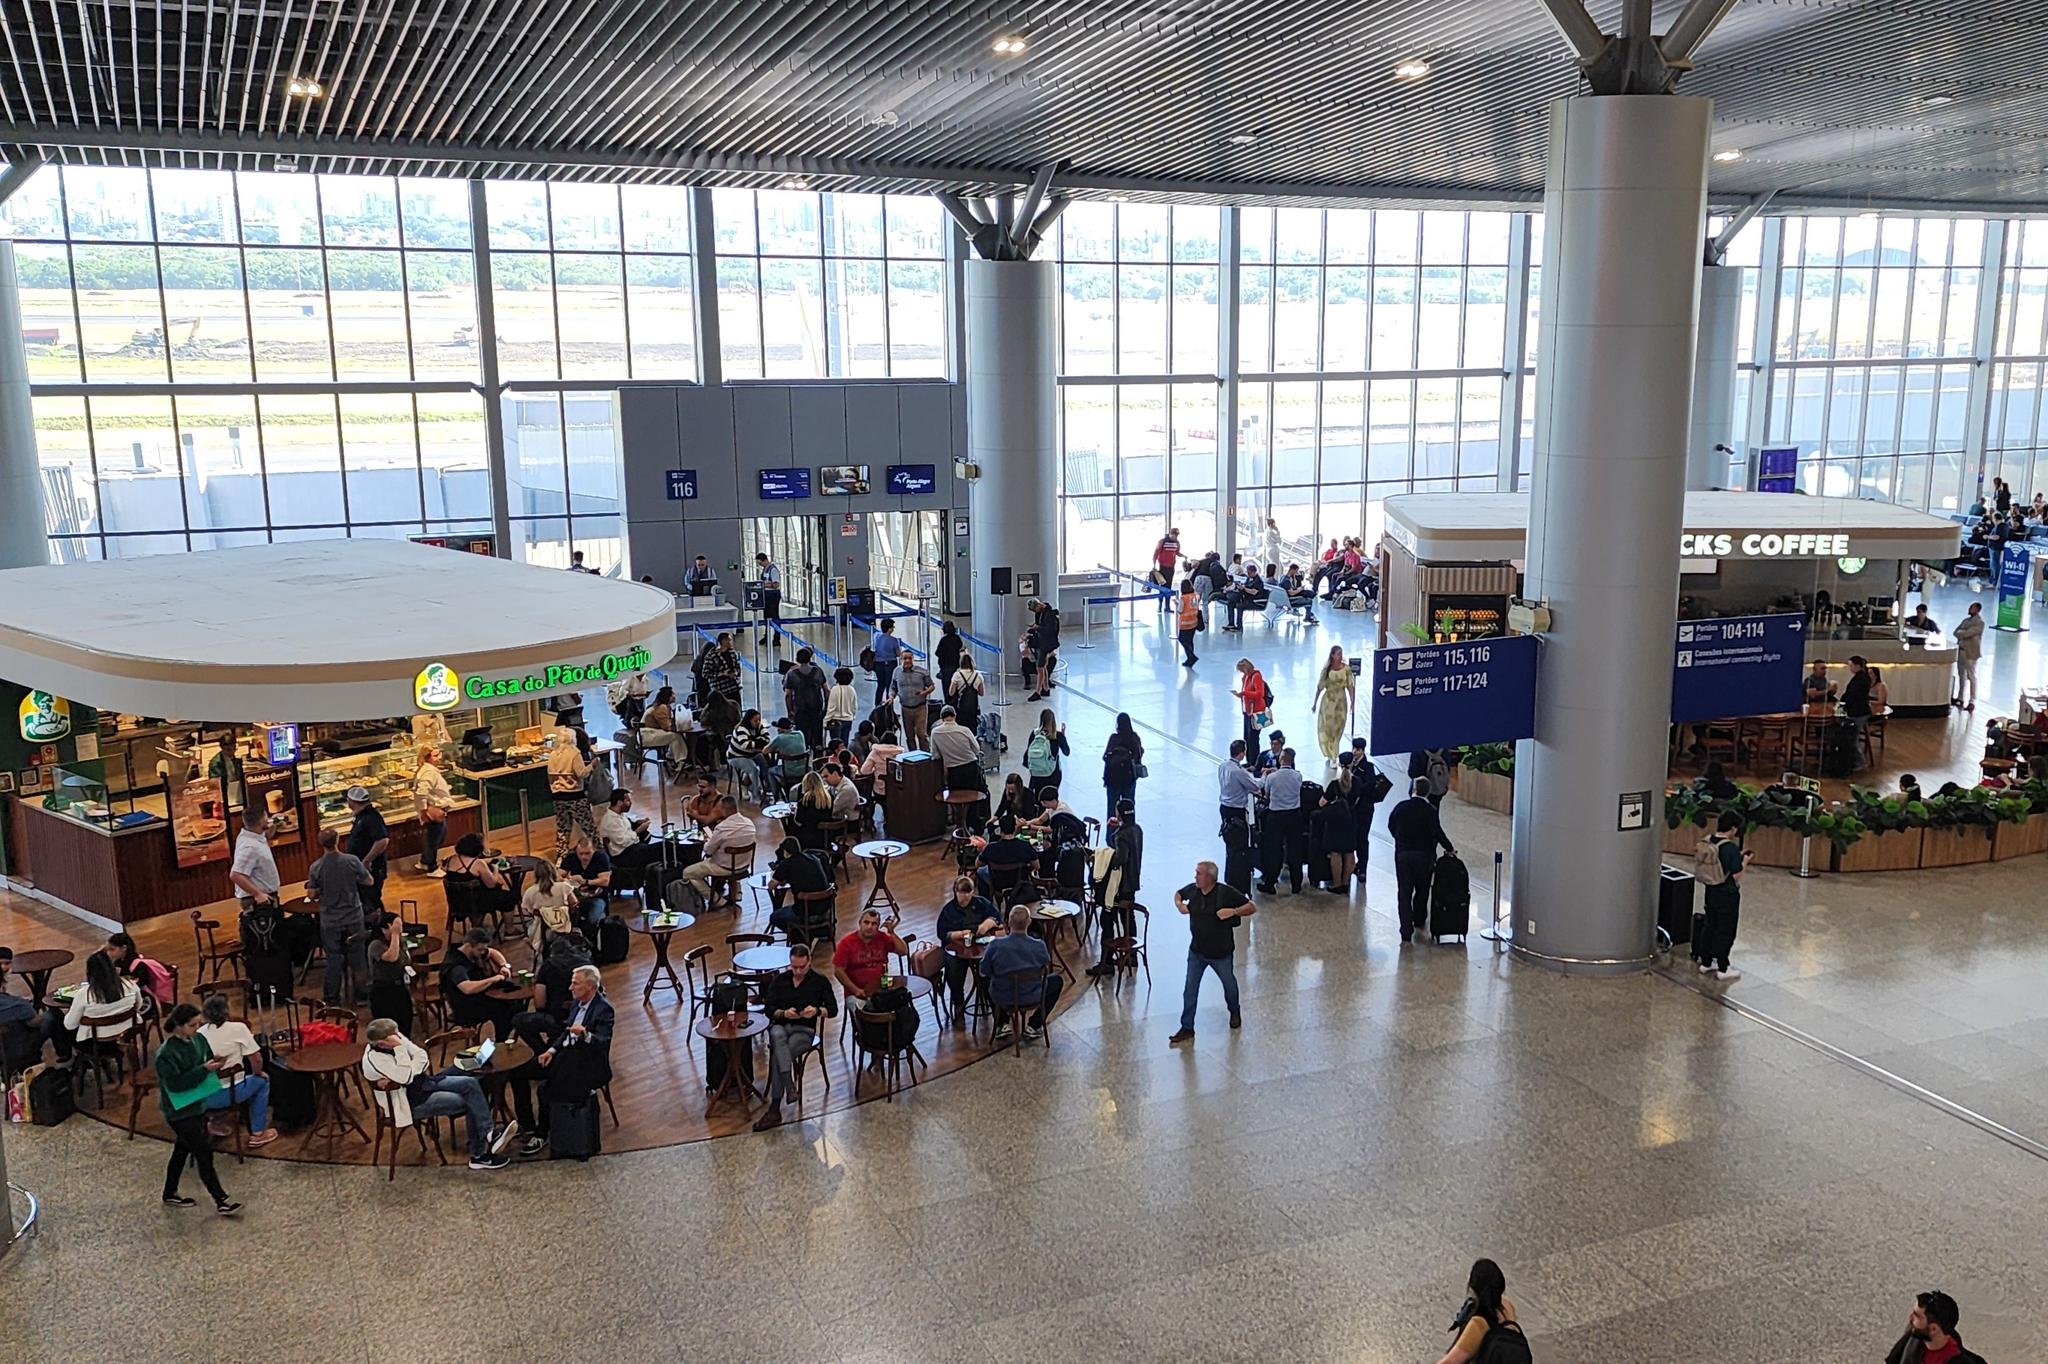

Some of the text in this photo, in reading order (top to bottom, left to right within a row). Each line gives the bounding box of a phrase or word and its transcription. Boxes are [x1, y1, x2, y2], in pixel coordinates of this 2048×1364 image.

[671, 482, 694, 497] 116
[1741, 534, 1850, 556] COFFEE
[838, 584, 844, 592] 2
[925, 582, 931, 590] P
[750, 591, 759, 600] D
[1721, 622, 1765, 640] 104-114
[1416, 651, 1440, 659] Portões
[1415, 660, 1434, 669] Gates
[465, 646, 652, 700] Casa do Pão de Queijo
[1415, 672, 1489, 692] Portões 117-124
[1414, 686, 1433, 695] Gates
